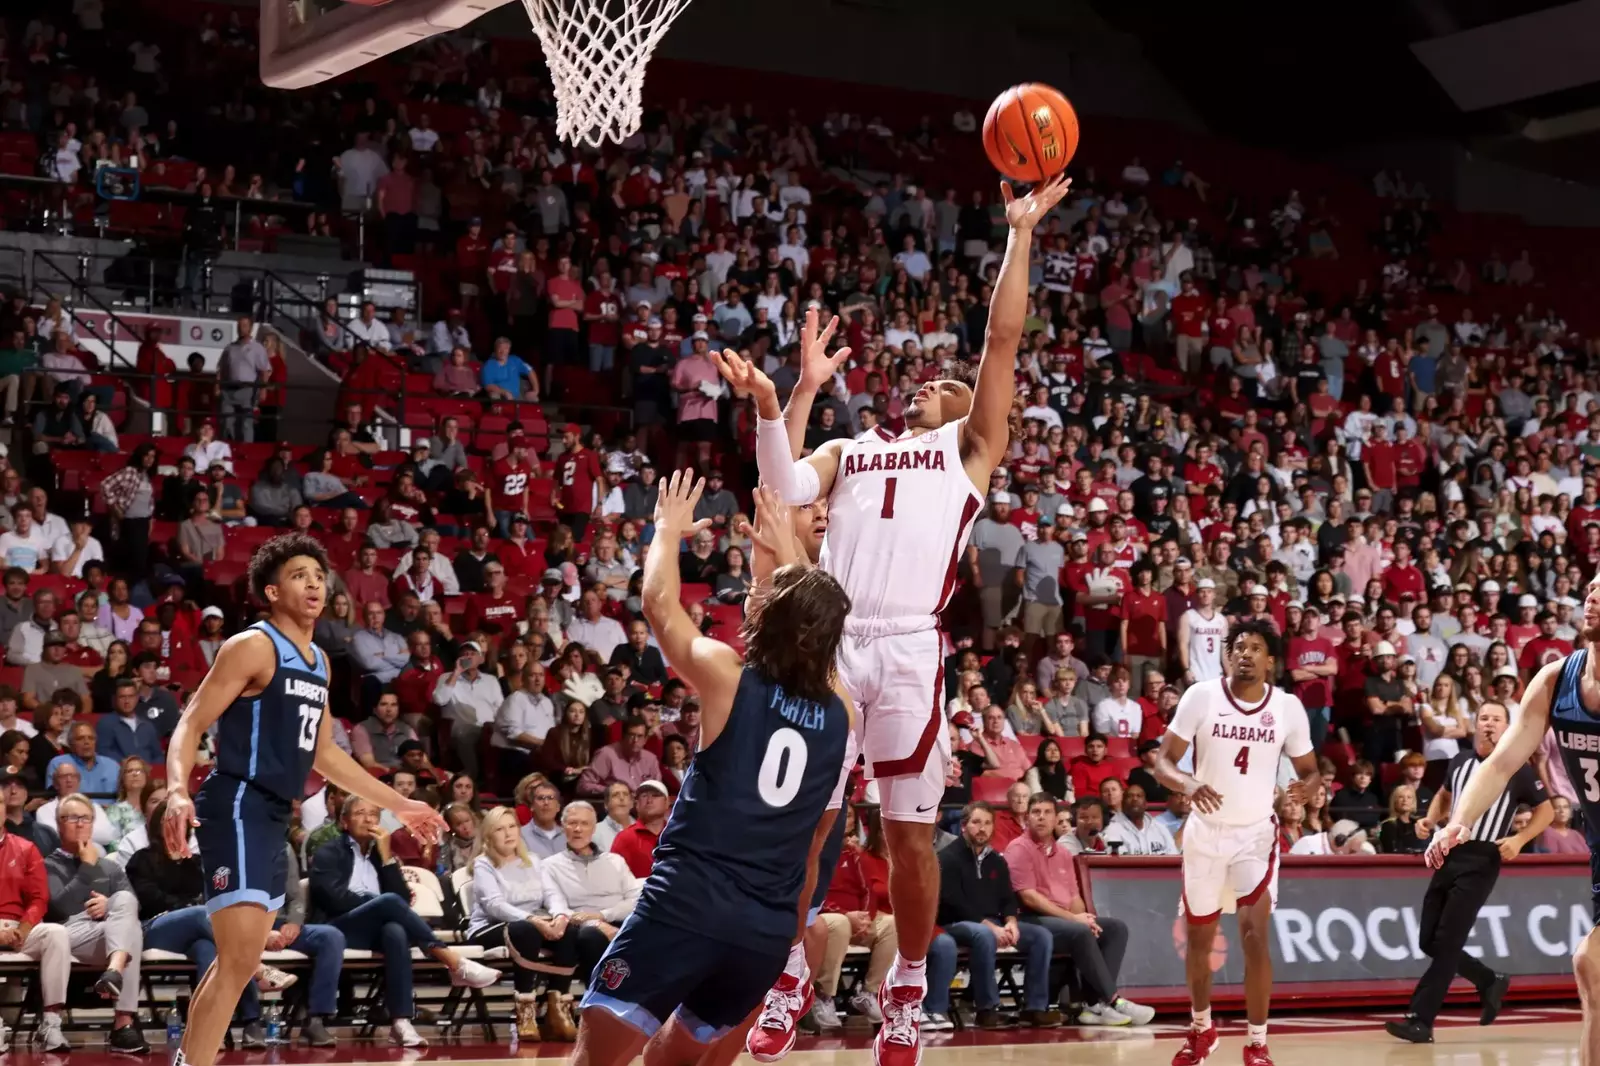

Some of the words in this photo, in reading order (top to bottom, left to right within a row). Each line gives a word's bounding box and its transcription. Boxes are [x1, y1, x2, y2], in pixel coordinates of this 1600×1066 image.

[563, 461, 577, 486] 2
[844, 449, 946, 477] ALABAMA
[503, 472, 527, 496] 22
[880, 477, 898, 519] 1
[1206, 637, 1214, 654] 3
[298, 703, 322, 752] 23
[1211, 723, 1276, 744] ALABAMA
[1558, 729, 1600, 754] LIBE
[757, 727, 808, 808] 0
[1234, 746, 1251, 776] 4
